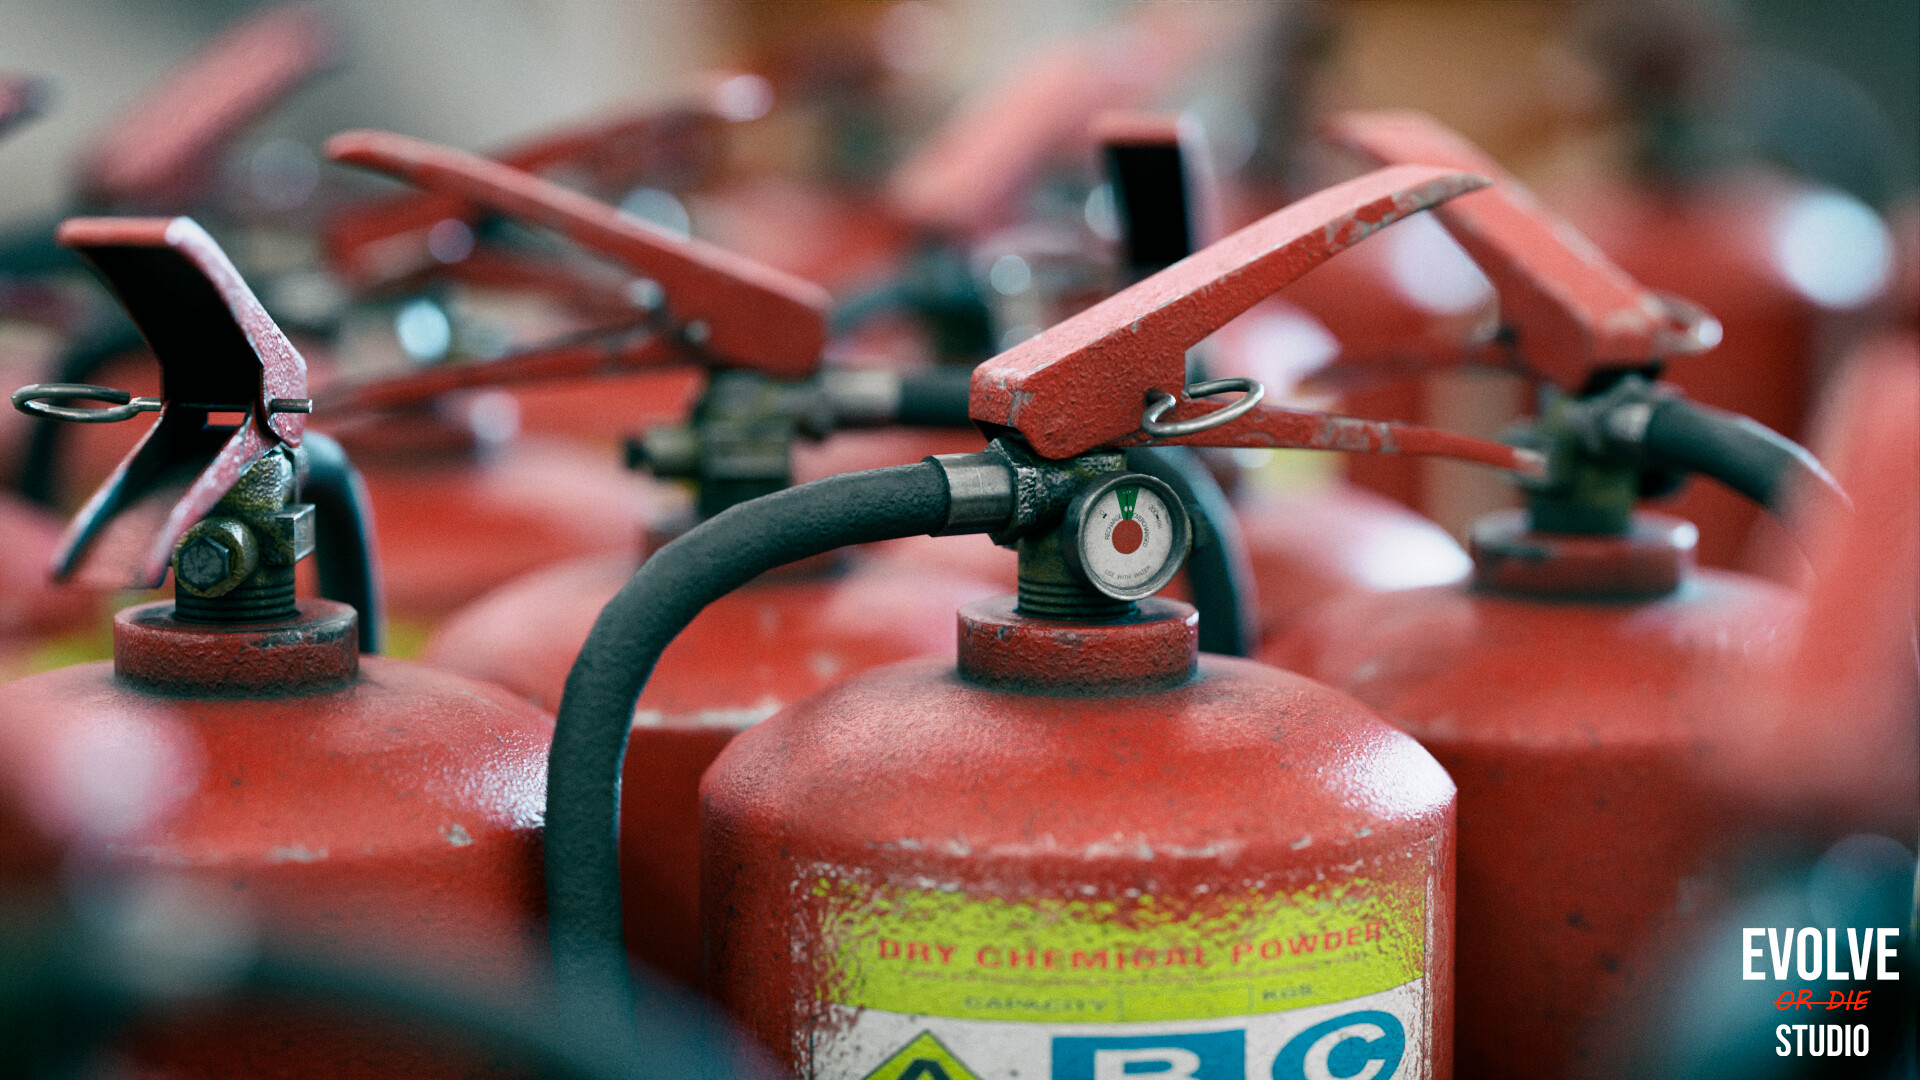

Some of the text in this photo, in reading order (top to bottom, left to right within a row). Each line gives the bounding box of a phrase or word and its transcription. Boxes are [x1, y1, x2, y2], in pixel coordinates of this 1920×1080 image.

[879, 938, 956, 965] DRY
[976, 945, 1208, 970] CHEMICAL
[1232, 921, 1382, 963] POWDER
[1303, 1022, 1387, 1080] C
